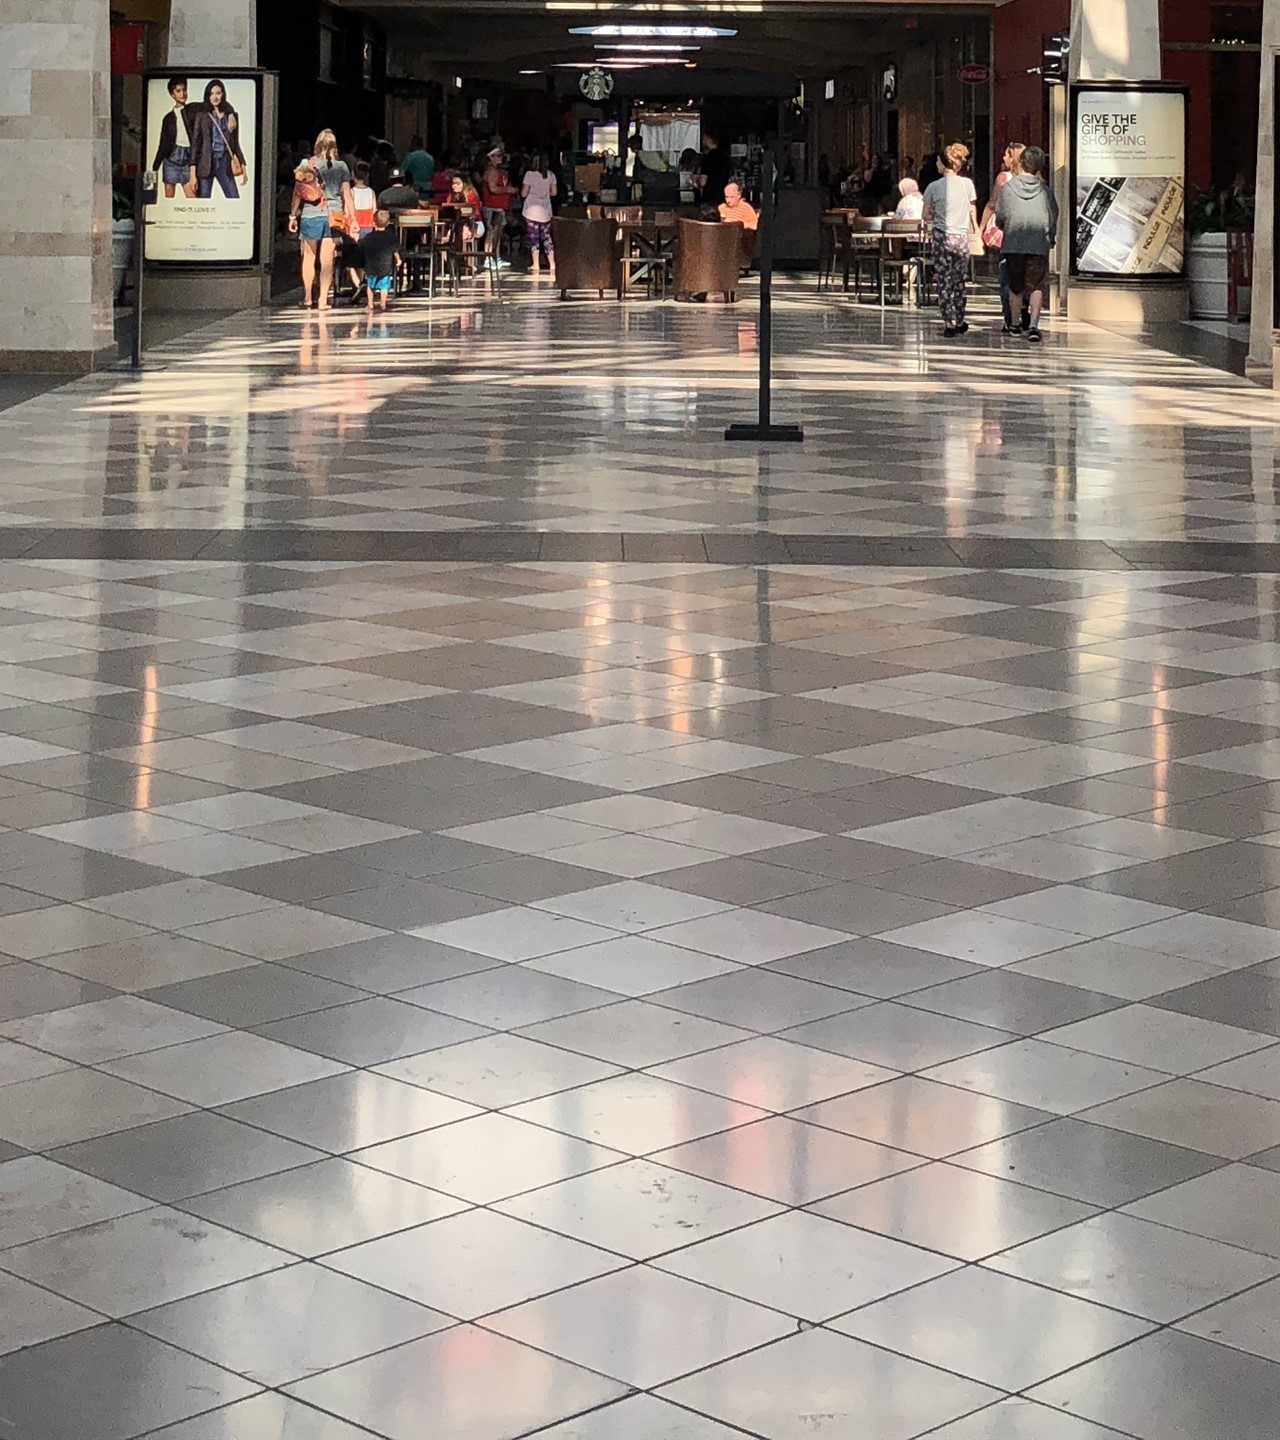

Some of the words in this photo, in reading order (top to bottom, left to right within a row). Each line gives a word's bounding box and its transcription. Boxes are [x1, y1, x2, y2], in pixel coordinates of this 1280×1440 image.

[1081, 113, 1109, 125] GIVE
[1111, 113, 1137, 125] THE
[1081, 124, 1109, 135] GIFT
[1111, 124, 1129, 135] OF
[1081, 135, 1146, 146] SHOPPING
